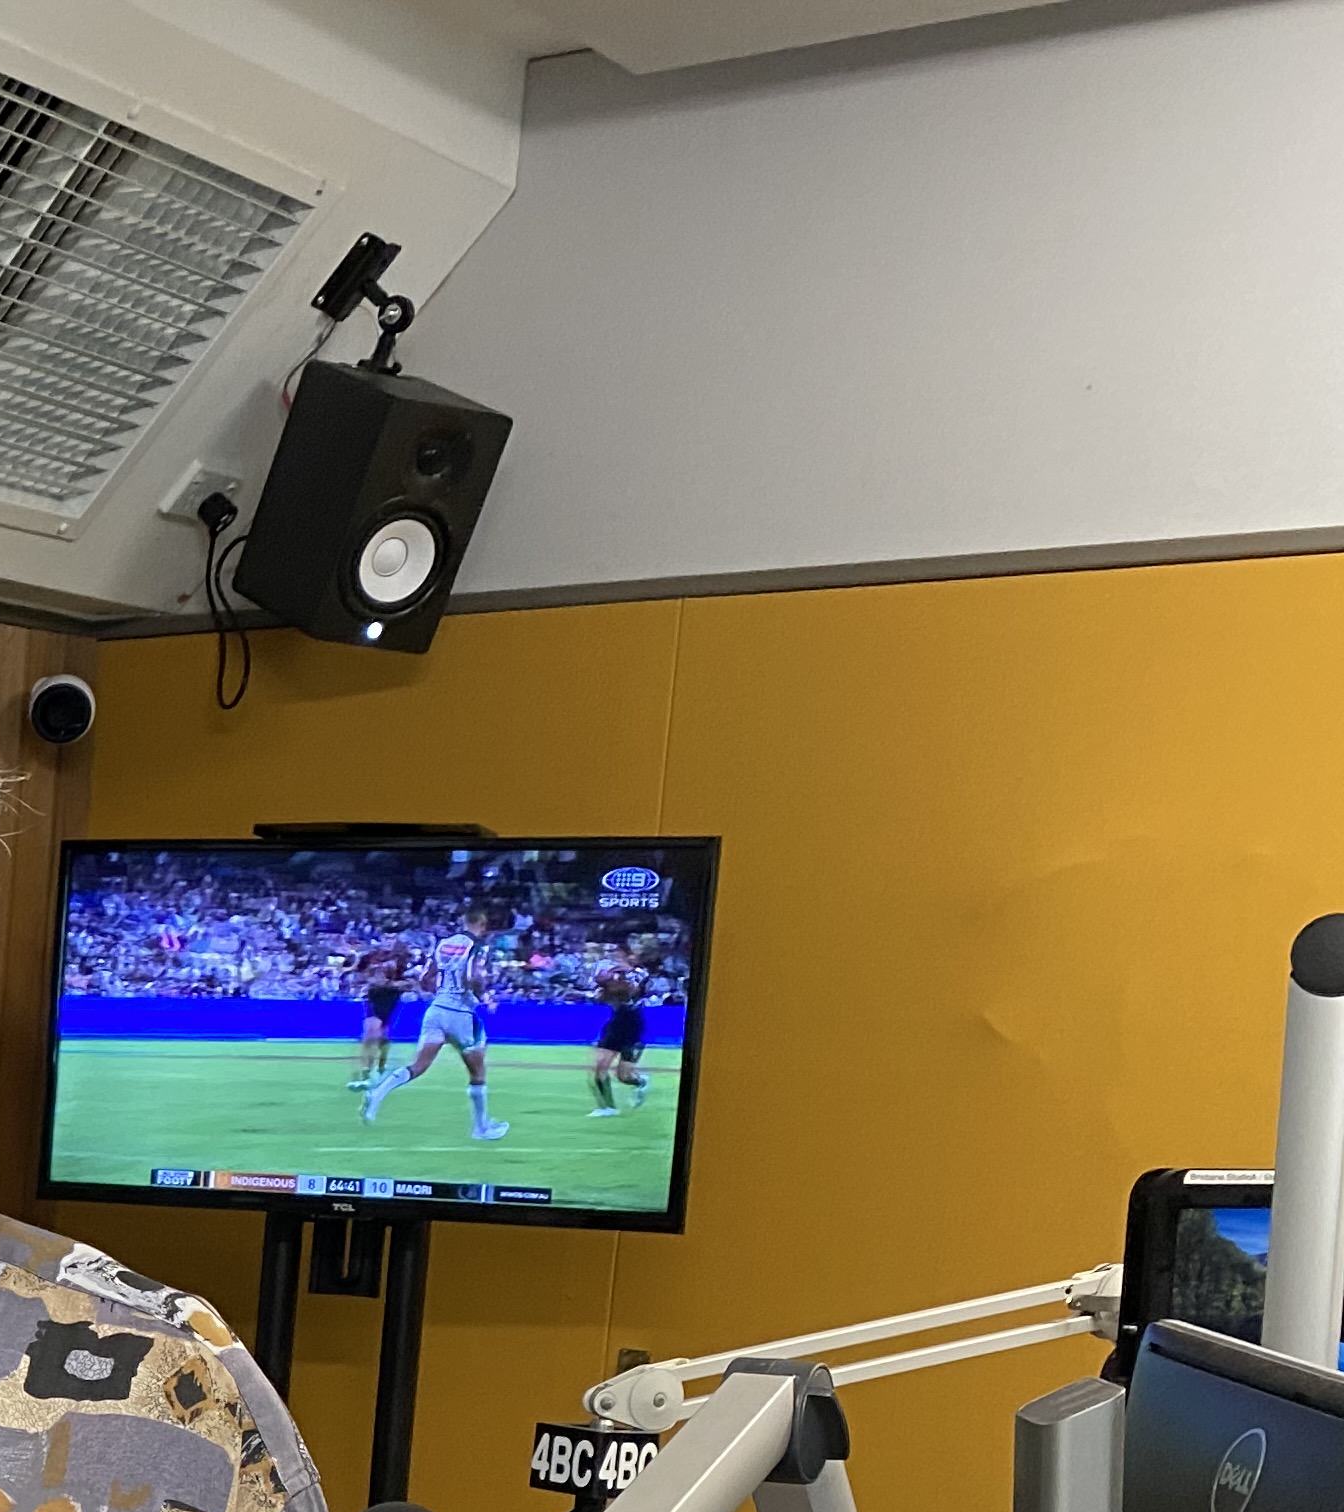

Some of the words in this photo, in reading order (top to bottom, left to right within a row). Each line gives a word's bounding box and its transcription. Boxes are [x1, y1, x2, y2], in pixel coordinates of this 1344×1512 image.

[599, 897, 660, 908] SPORTS
[231, 1176, 296, 1189] INDIGENOUS
[308, 1179, 316, 1191] 8
[329, 1179, 360, 1193] 64:41
[372, 1181, 387, 1194] 10
[395, 1183, 432, 1196] MAORI
[332, 1203, 355, 1212] TCL
[531, 1432, 594, 1488] 4BC
